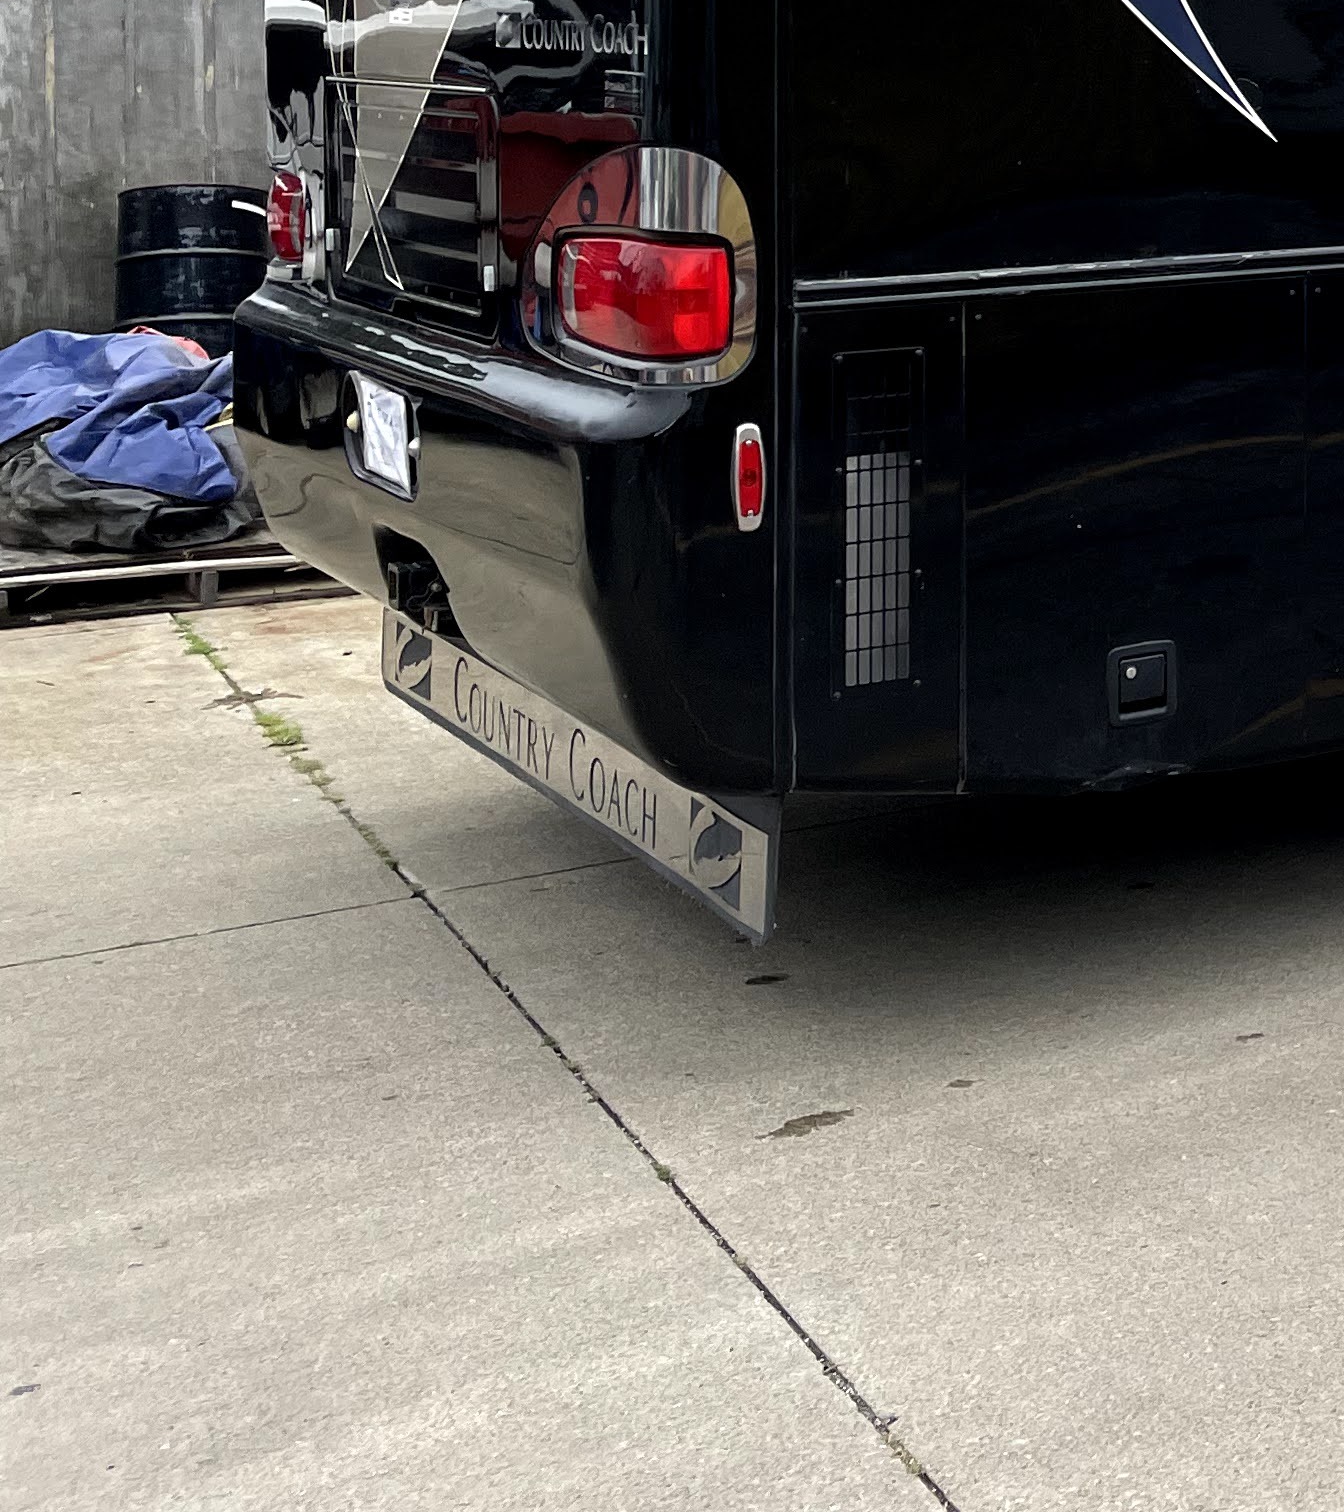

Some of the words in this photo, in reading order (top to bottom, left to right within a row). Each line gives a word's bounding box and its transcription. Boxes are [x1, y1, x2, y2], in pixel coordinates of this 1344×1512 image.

[521, 13, 588, 51] COUNTRY
[590, 13, 648, 55] COACH
[454, 656, 554, 780] COUNTRY
[569, 728, 656, 850] COACH
